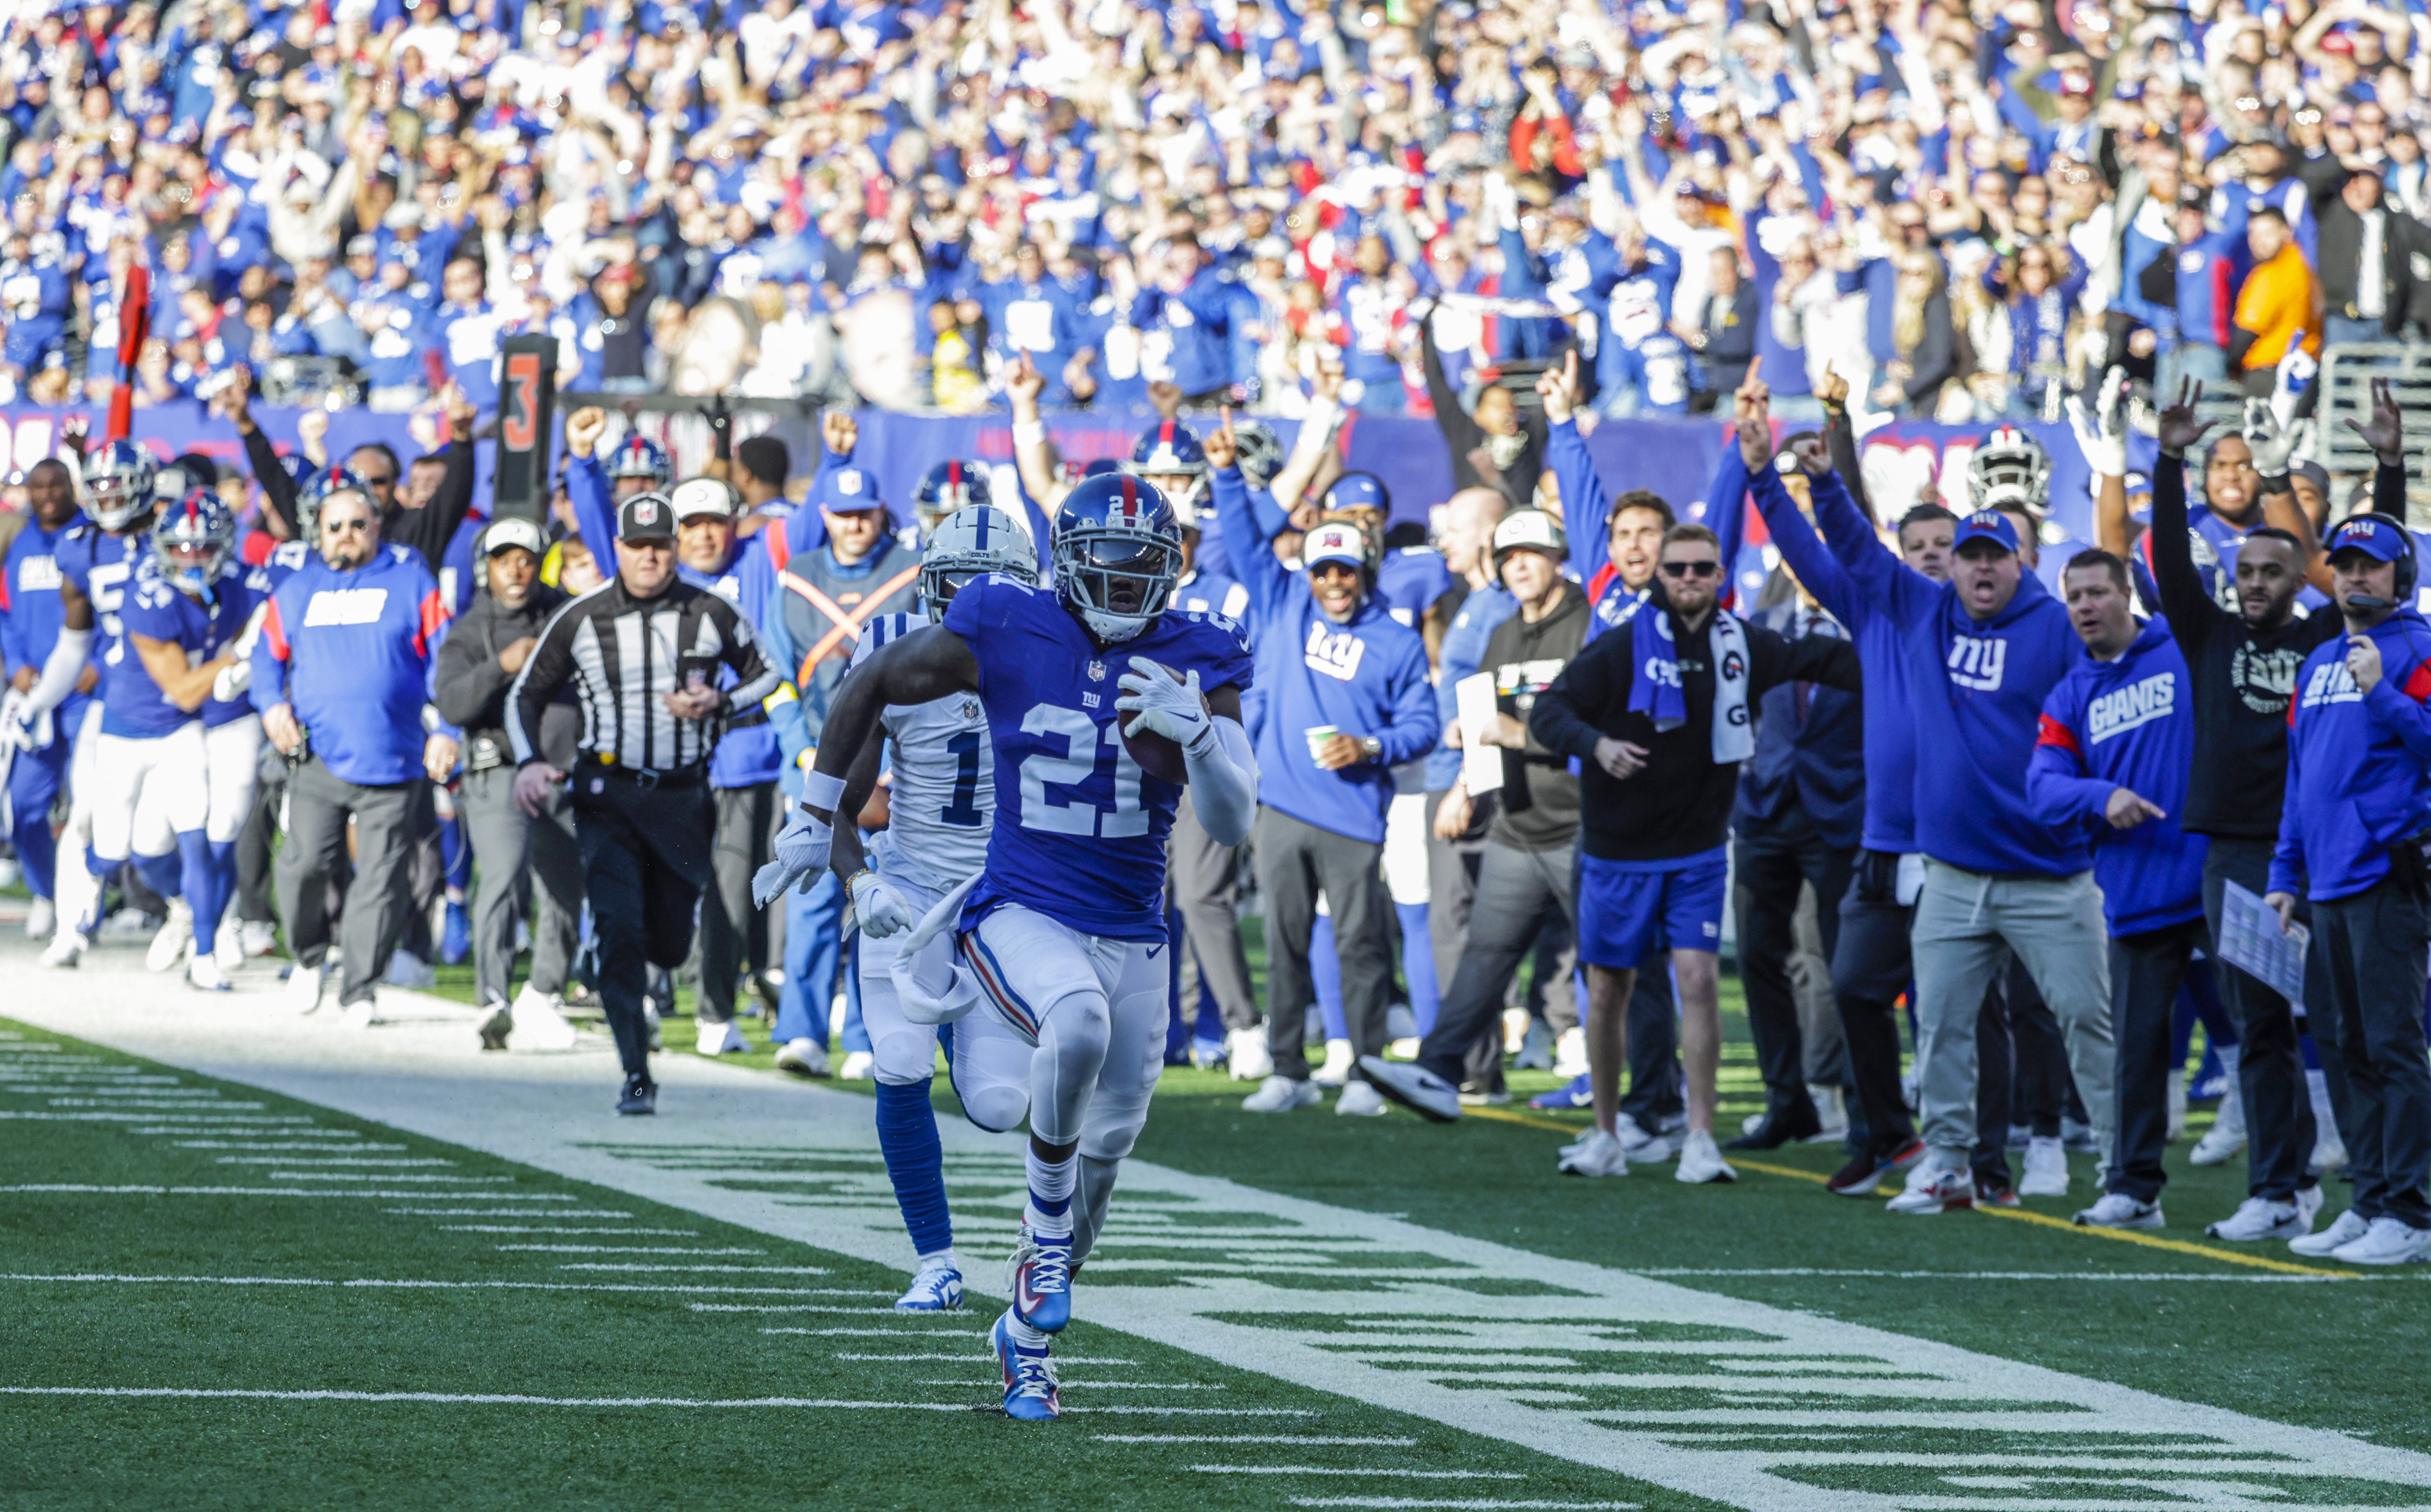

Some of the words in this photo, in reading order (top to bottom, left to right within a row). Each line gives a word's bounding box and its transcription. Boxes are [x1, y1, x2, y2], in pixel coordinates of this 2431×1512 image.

[503, 354, 540, 451] 3
[1109, 496, 1144, 518] 21
[1092, 668, 1103, 678] NFL
[1947, 635, 2007, 692] ny
[1082, 691, 1101, 709] ny
[1727, 705, 1746, 725] G
[2089, 672, 2175, 736] GIANTS
[942, 732, 982, 826] 1
[1019, 702, 1150, 838] 21
